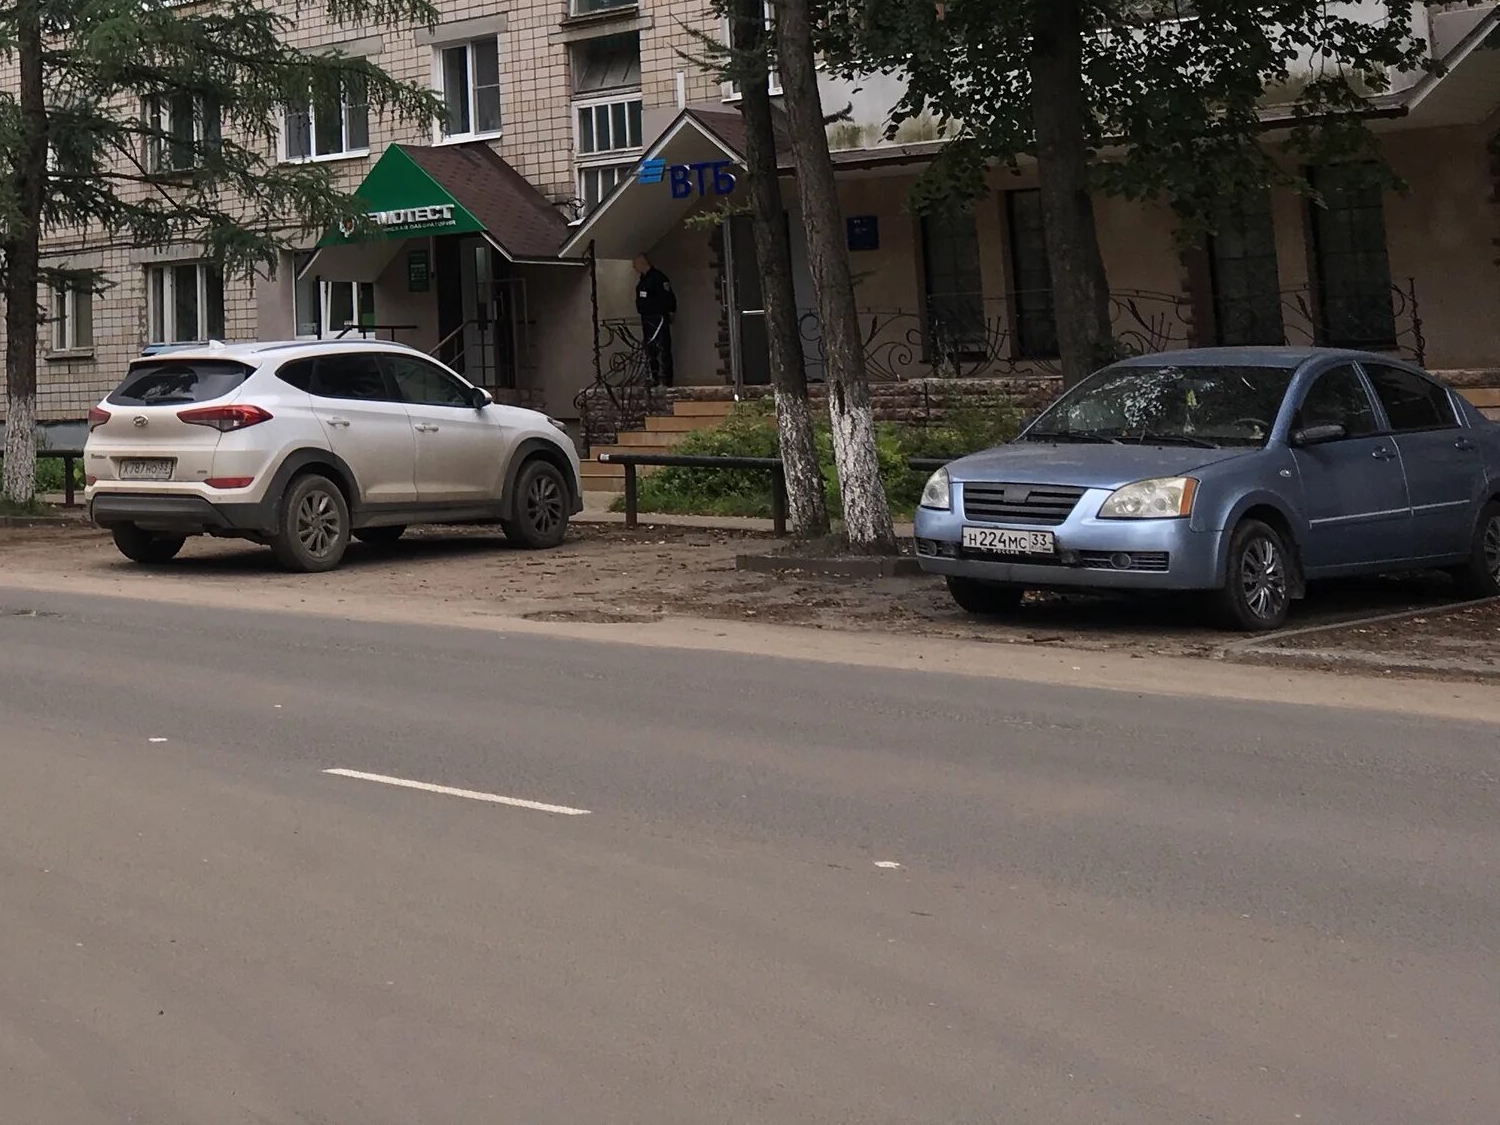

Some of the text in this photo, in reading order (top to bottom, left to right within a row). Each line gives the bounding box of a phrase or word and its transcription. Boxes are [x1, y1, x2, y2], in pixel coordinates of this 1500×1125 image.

[670, 161, 737, 199] ВТБ
[969, 531, 1047, 550] Н224МС 33
